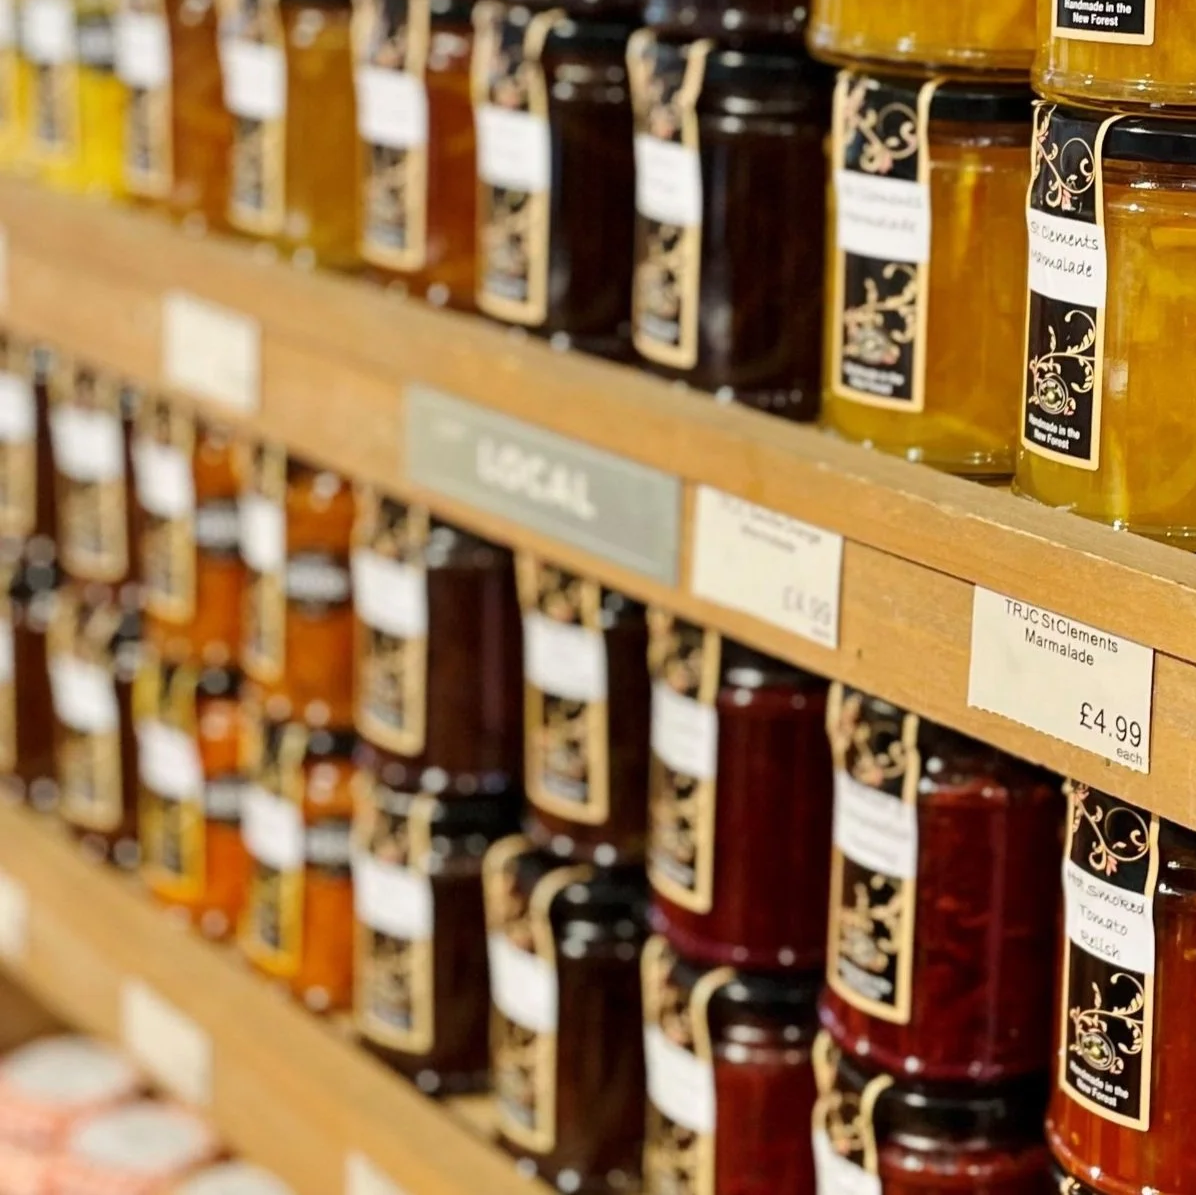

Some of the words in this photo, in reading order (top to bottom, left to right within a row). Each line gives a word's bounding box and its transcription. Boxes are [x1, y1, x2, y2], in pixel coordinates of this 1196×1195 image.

[1090, 13, 1119, 27] Forest
[1105, 1, 1114, 13] in
[1116, 2, 1132, 14] the
[1004, 598, 1040, 626] TRJC
[1041, 612, 1055, 632] St
[1056, 618, 1119, 654] Clements
[1024, 626, 1095, 667] Marmalade
[1079, 701, 1143, 748] £4.99
[1116, 746, 1143, 766] each
